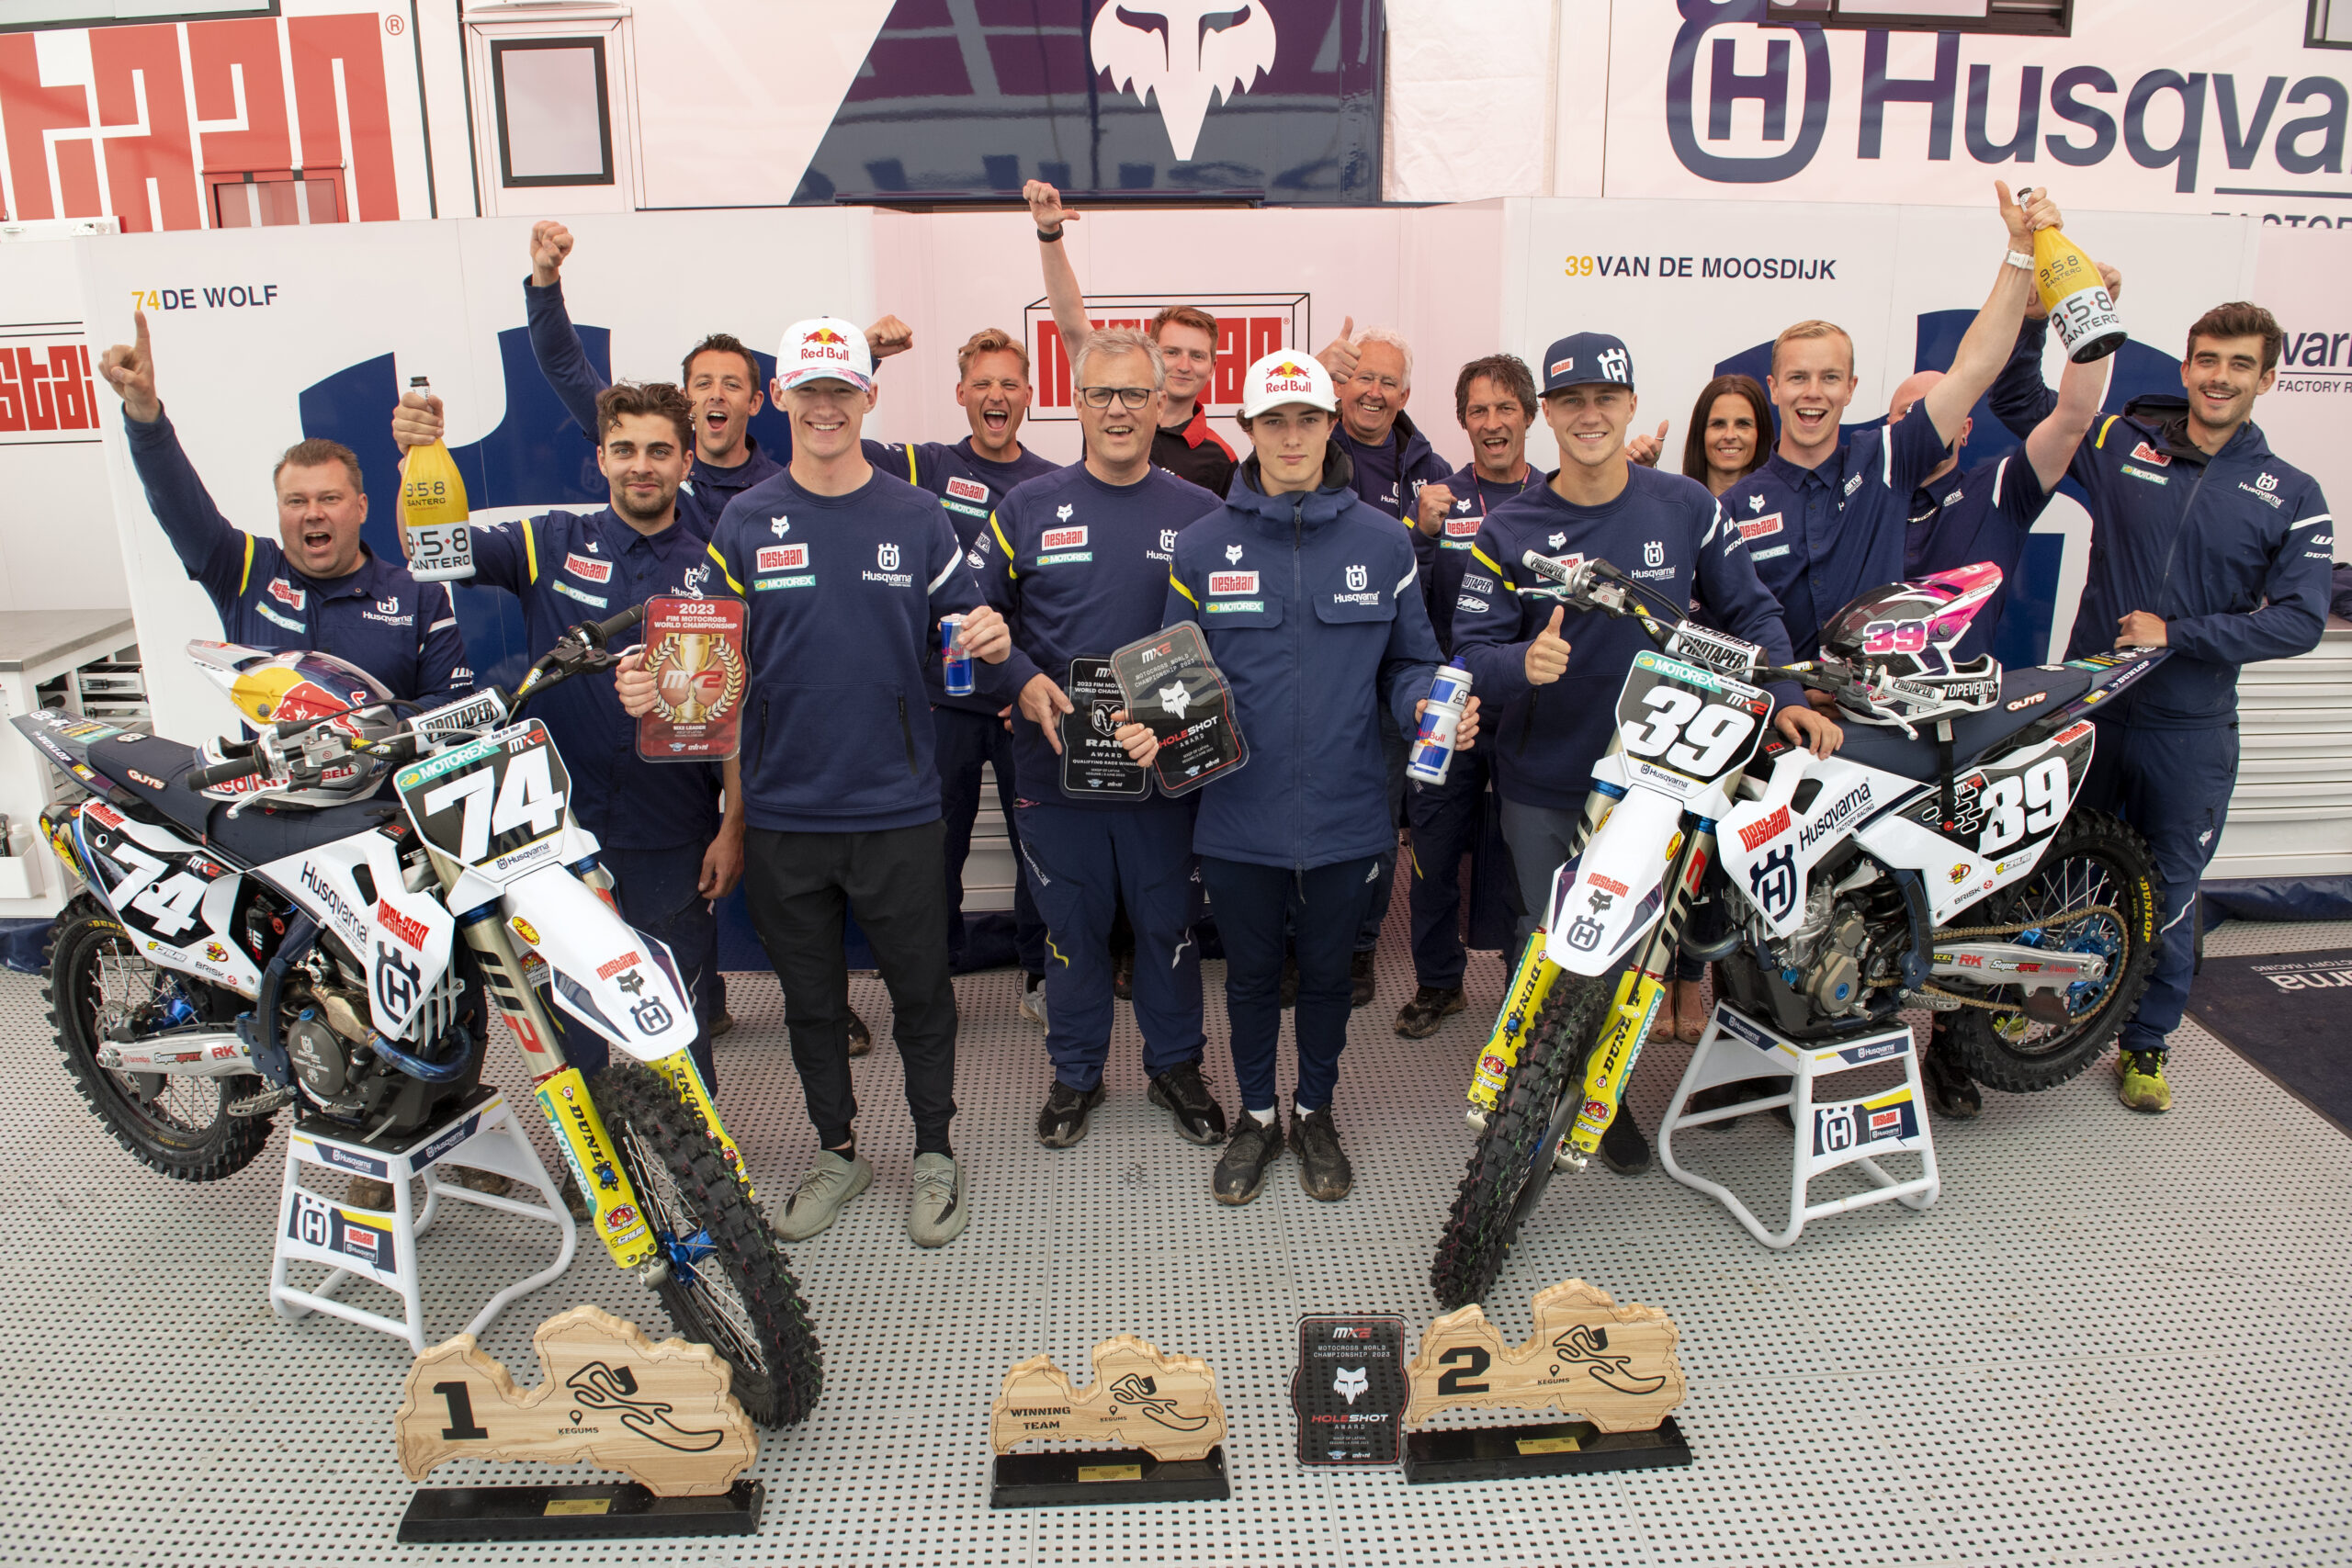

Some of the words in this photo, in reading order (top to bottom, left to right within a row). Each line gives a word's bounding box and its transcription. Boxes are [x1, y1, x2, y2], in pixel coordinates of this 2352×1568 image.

[1858, 29, 2352, 193] Husqva
[1565, 255, 1593, 276] 39
[1598, 256, 1650, 276] VAN
[1659, 256, 1694, 277] DE
[1702, 257, 1837, 279] MOOSDIJK
[2045, 266, 2082, 288] SANTERO
[131, 290, 160, 310] 74
[162, 288, 196, 310] DE
[204, 285, 278, 308] WOLF
[801, 347, 826, 361] Red
[827, 347, 850, 362] Bull
[1266, 379, 1288, 393] Red
[1289, 379, 1312, 393] Bull
[2278, 380, 2341, 393] FACTORY
[407, 497, 446, 506] SANTERO
[2238, 481, 2282, 507] Husqvarna
[950, 502, 988, 517] MOTOREX
[1045, 529, 1084, 548] nestaan
[1452, 541, 1475, 549] MOTO
[413, 555, 470, 570] ANTERO
[568, 557, 609, 581] nestaan
[761, 548, 803, 570] nestaan
[1049, 552, 1091, 563] MOTOREX
[1531, 555, 1566, 580] PROTAPER
[766, 575, 814, 590] MOTOREX
[862, 570, 911, 583] Husqvarna
[1212, 575, 1254, 592] nestaan
[1631, 568, 1675, 580] Husqvarna
[679, 603, 716, 615] 2023
[1220, 602, 1262, 613] MOTOREX
[1334, 592, 1379, 605] Husqvarna
[363, 611, 413, 625] Husqvarna
[683, 622, 738, 630] CHAMPIONSHIP
[1861, 618, 1928, 655] 39
[1142, 641, 1172, 664] MX2
[1680, 634, 1747, 672] PROTAPER
[1094, 667, 1114, 678] MX
[1135, 661, 1169, 680] MOTOCROSS
[1170, 653, 1190, 665] WORLD
[1135, 665, 1178, 688] CHAMPIONSHIP
[1180, 658, 1195, 670] 2023
[1654, 659, 1715, 689] MOTOREX
[2116, 660, 2151, 684] DUNLOP
[662, 670, 725, 689] MX2
[1725, 691, 1769, 716] MX2
[2007, 692, 2047, 713] GUTS
[421, 699, 498, 742] PROTAPER
[1622, 685, 1755, 777] 39
[508, 728, 547, 754] MX2
[1159, 716, 1219, 750] HOLESHOT
[1430, 731, 1446, 743] Bull
[37, 734, 73, 761] DUNLOP
[420, 741, 492, 781] MOTOREX
[128, 769, 167, 790] GUTS
[322, 767, 356, 780] BELL
[1649, 768, 1687, 789] Husqvarna
[424, 745, 566, 862] 74
[1979, 757, 2071, 853] 39
[1799, 780, 1871, 852] Husqvarna
[1737, 804, 1792, 853] nestaan
[187, 854, 221, 877] MX2
[507, 842, 548, 866] Husqvarna
[108, 842, 209, 939] 74
[1588, 873, 1630, 898] nestaan
[1954, 886, 1982, 905] BRISK
[300, 861, 368, 945] Husqvarna
[2139, 881, 2154, 943] DUNLOP
[377, 897, 430, 952] nestaan
[195, 961, 225, 978] BRISK
[595, 950, 643, 981] nestaan
[1933, 952, 1953, 961] XCEL
[1958, 953, 1984, 967] RK
[1629, 994, 1664, 1072] MOTOREX
[211, 1044, 236, 1059] RK
[1865, 1043, 1894, 1057] Husqvarna
[569, 1103, 605, 1164] DUNL
[549, 1121, 595, 1203] MOTOREX
[1332, 1326, 1373, 1338] MX2
[1438, 1346, 1490, 1396] 2
[433, 1381, 489, 1440] 1
[1011, 1406, 1071, 1417] WINNING
[1311, 1414, 1389, 1424] HOLESHOT
[1023, 1420, 1060, 1431] TEAM
